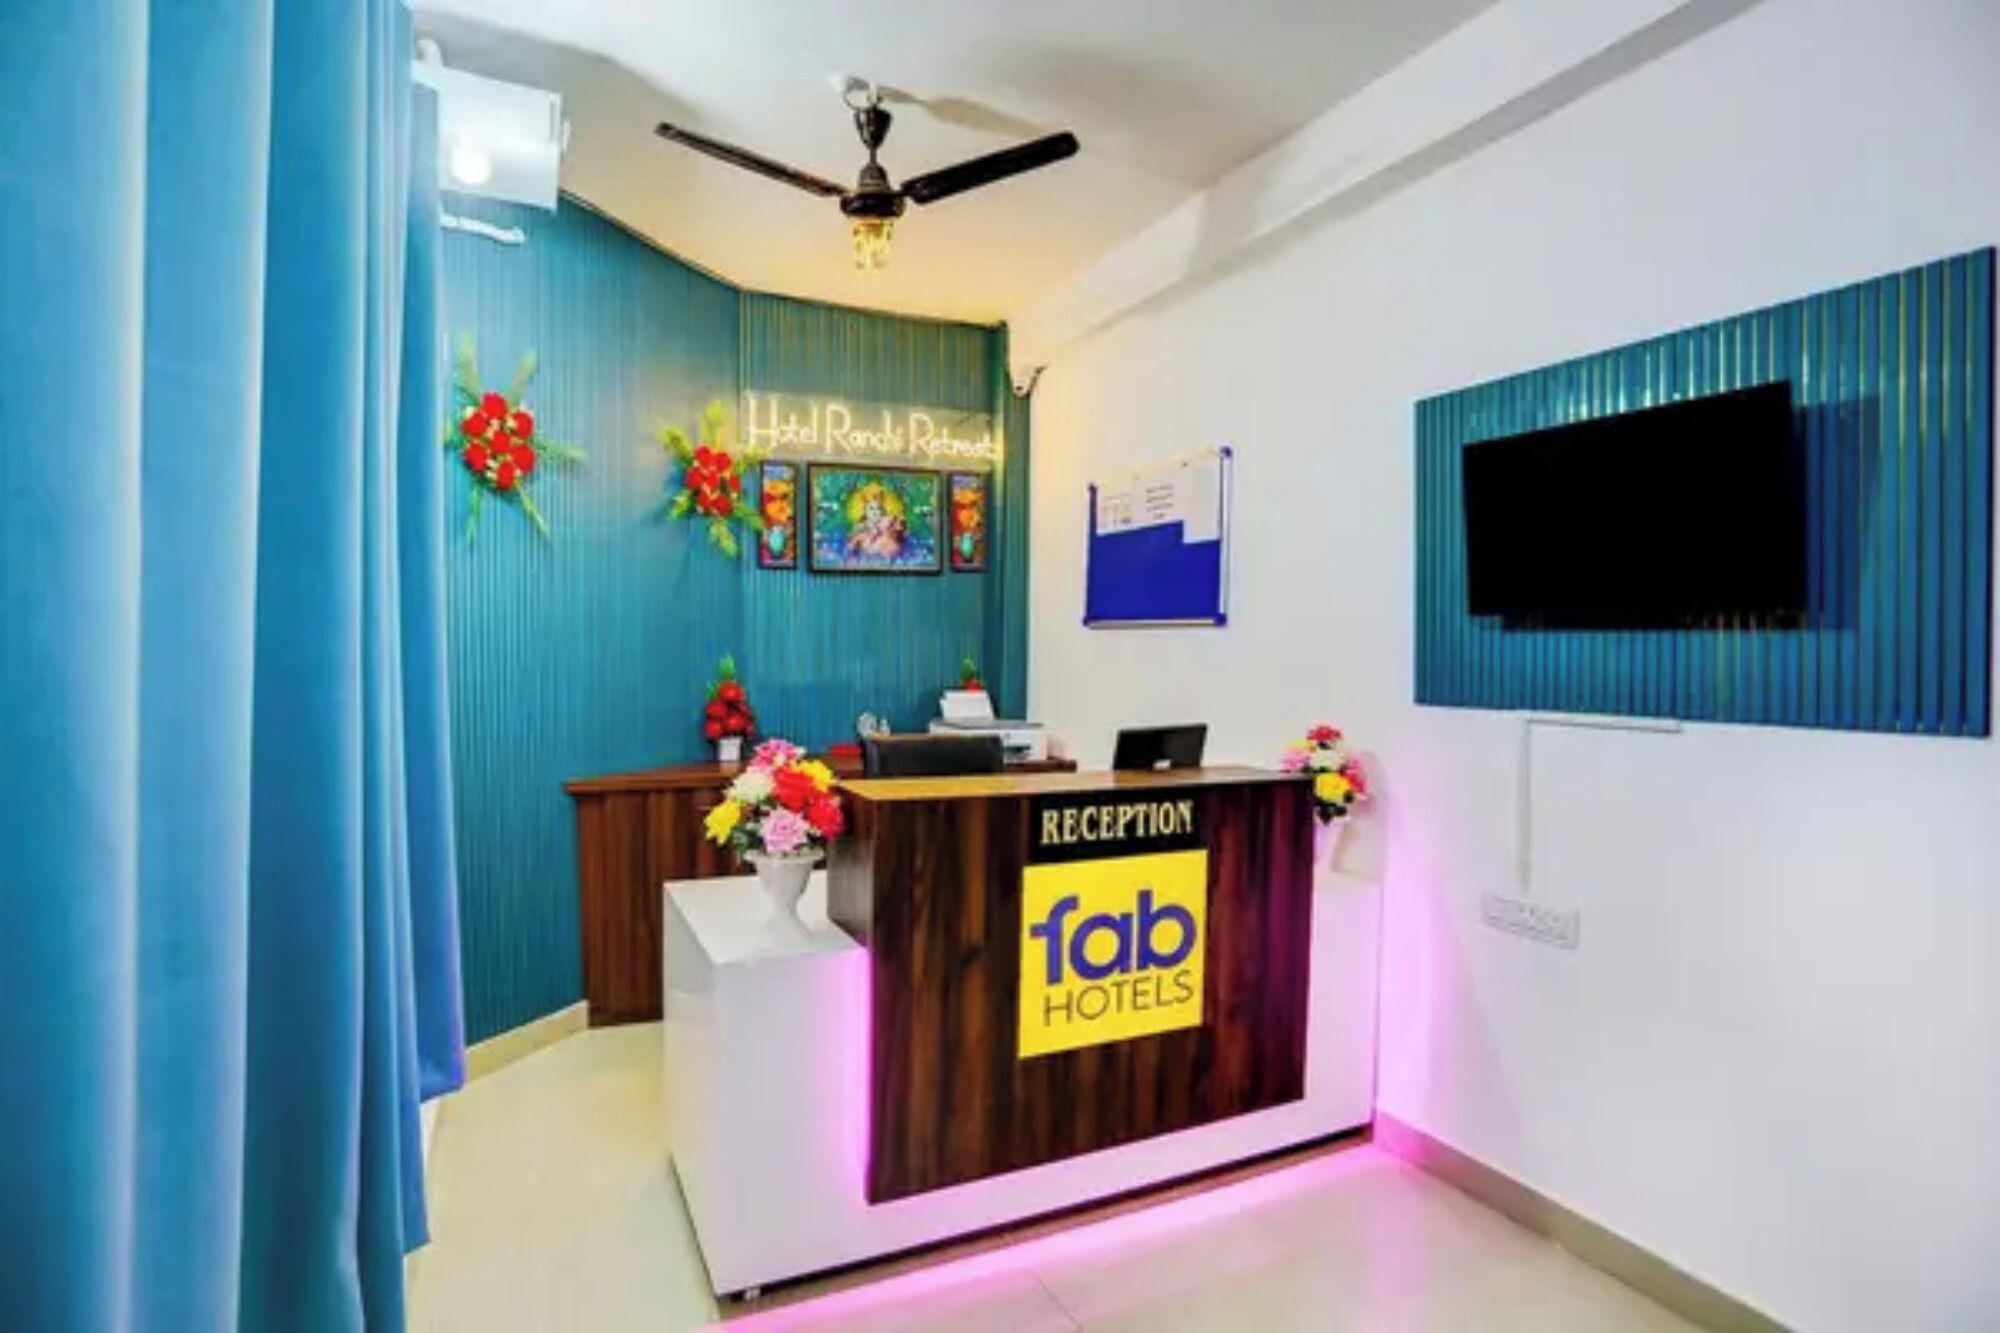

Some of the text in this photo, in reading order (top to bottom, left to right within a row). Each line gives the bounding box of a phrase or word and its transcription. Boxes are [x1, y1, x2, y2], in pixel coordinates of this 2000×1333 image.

[747, 397, 818, 448] Hotel
[1040, 800, 1194, 845] RECEPTION
[1029, 889, 1196, 986] fab
[1043, 969, 1195, 1026] HOTELS
